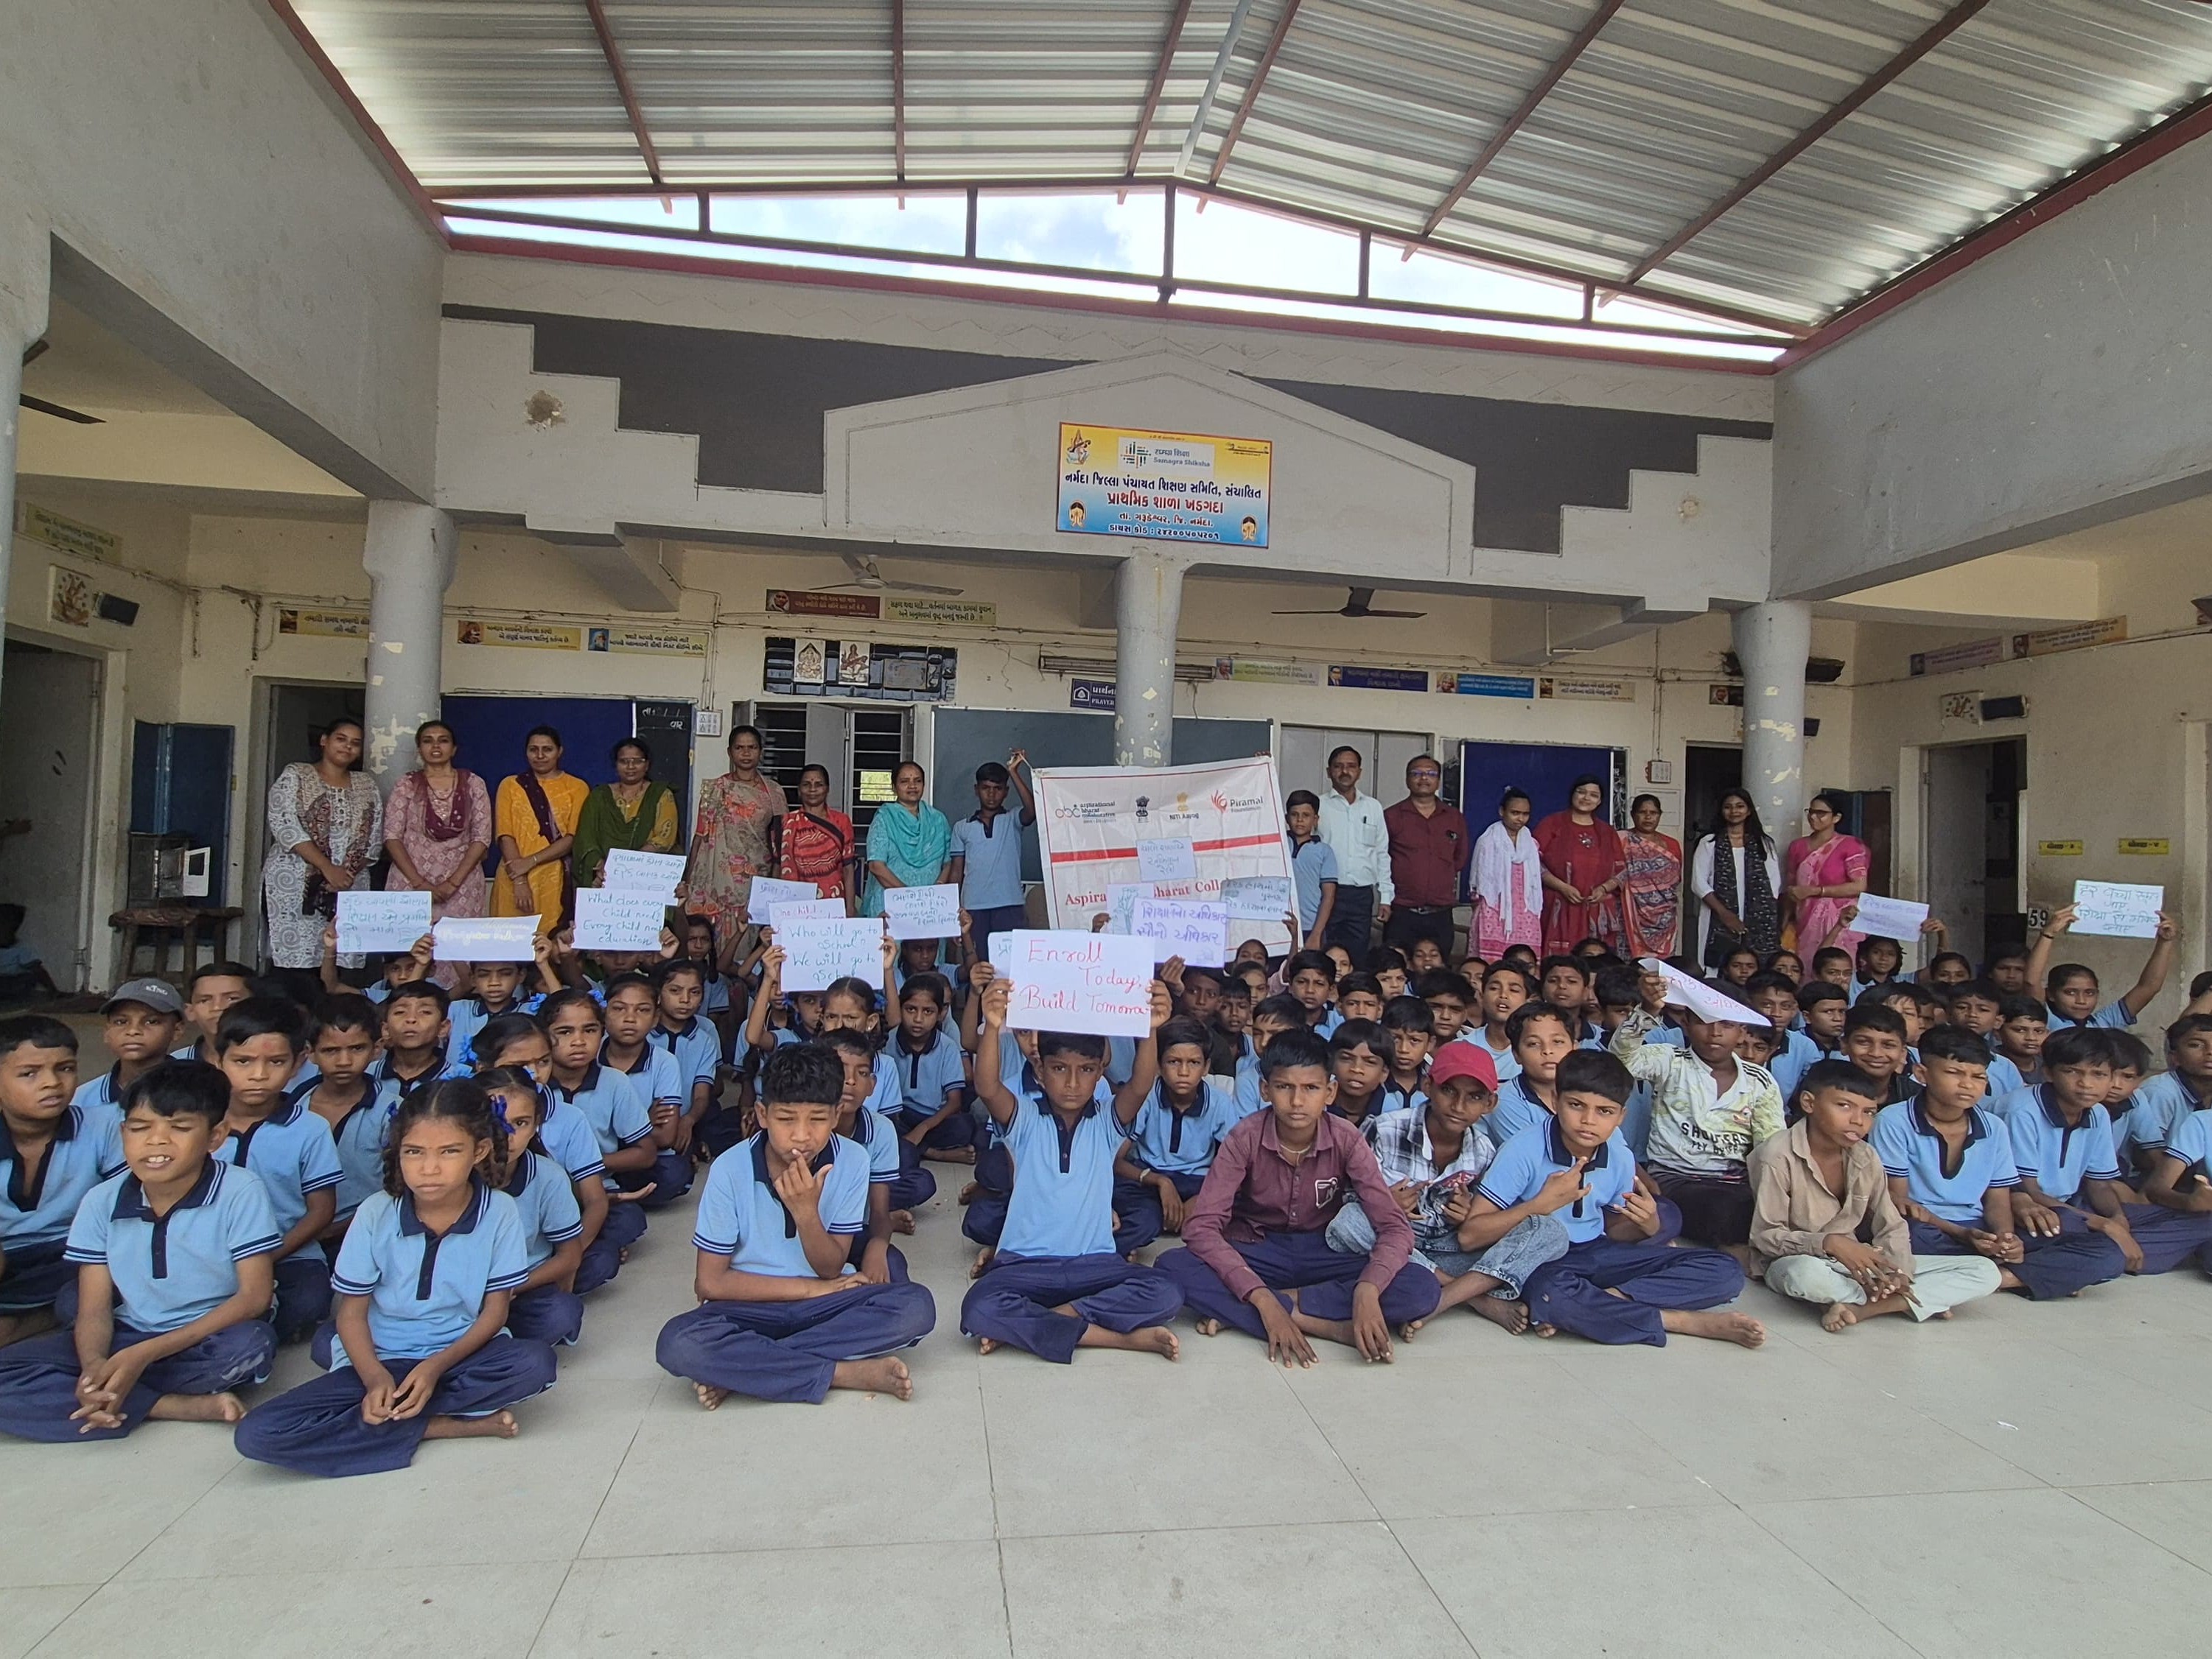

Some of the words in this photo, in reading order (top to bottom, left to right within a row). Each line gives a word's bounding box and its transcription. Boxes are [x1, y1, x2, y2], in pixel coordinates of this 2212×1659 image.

[1153, 457, 1183, 466] Samagra
[1184, 459, 1211, 467] Shiksha
[1065, 470, 1089, 484] નર્મદા
[1093, 471, 1119, 487] જિલ્લા
[1123, 474, 1155, 490] પંચાયત
[1158, 477, 1187, 493] શિક્ષણ
[1190, 480, 1222, 497] સમિતિ,
[1225, 483, 1261, 499] સંચાલિત
[1107, 490, 1149, 508] પ્રાથમિક
[1153, 496, 1180, 510] શાળા
[1185, 499, 1224, 514] ખડગદા
[1119, 513, 1131, 521] તા.
[1174, 515, 1186, 525] જિ.
[1189, 517, 1214, 527] નર્મદા.
[1230, 796, 1264, 807] Piramal
[1065, 891, 1107, 909] Aspira
[1195, 878, 1220, 893] Coll
[2029, 909, 2048, 928] 59
[788, 922, 816, 939] Who
[820, 922, 844, 937] will
[852, 927, 864, 941] go
[867, 925, 878, 935] to
[1028, 939, 1104, 963] Enroll
[793, 953, 812, 967] We
[816, 952, 841, 967] will
[850, 956, 863, 970] go
[867, 953, 875, 963] to
[1018, 984, 1079, 1011] Build
